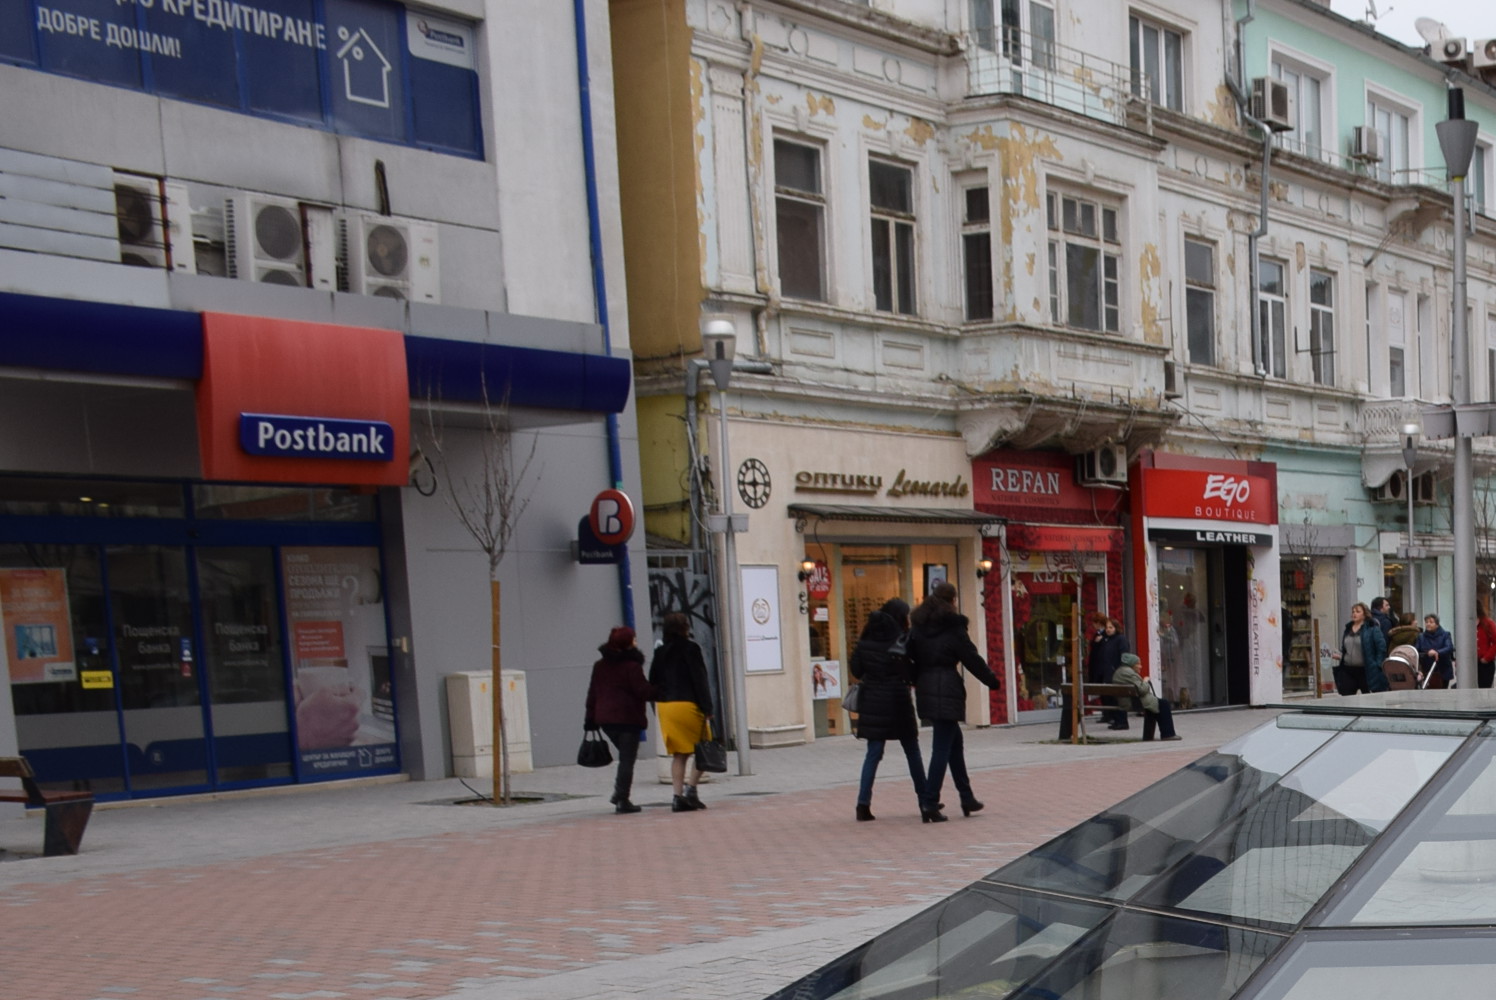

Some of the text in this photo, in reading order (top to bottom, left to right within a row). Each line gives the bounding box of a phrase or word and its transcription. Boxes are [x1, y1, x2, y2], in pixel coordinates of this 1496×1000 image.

[37, 6, 182, 58] ДОБРЕ ДОШЛИ!
[163, 0, 326, 50] КРЕДИТИРАНЕ
[258, 421, 385, 454] Postbank
[887, 468, 969, 498] Leonardo
[991, 467, 1060, 495] REFAN
[1203, 474, 1250, 507] EGO
[1194, 506, 1256, 520] BOUTIQUE
[1196, 531, 1257, 544] LEATHER
[123, 623, 180, 638] Пощенска
[215, 622, 269, 636] Пощенска
[1252, 615, 1260, 676] LEATHER
